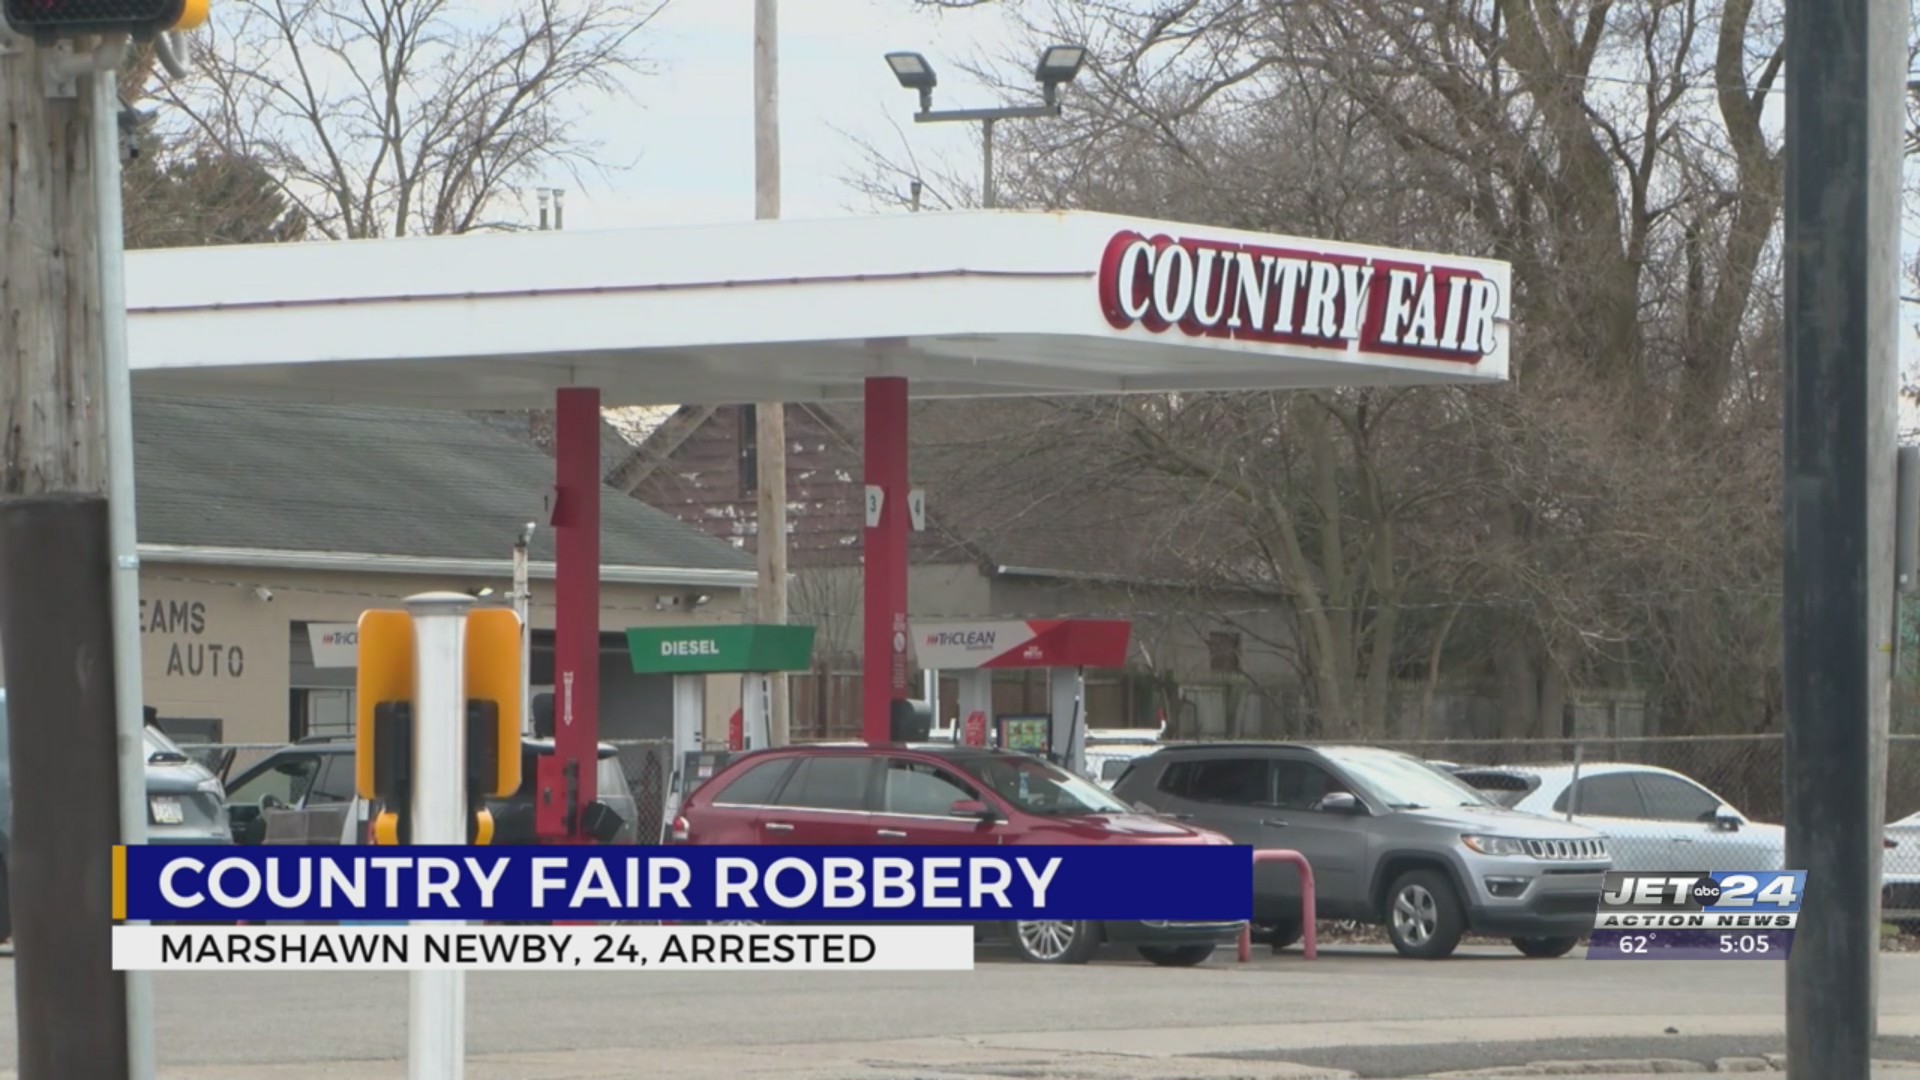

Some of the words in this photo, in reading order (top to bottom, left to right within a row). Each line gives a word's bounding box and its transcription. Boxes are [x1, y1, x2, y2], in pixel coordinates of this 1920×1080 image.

[1118, 240, 1374, 340] COUNTRY
[1380, 268, 1500, 355] FAIR
[869, 494, 877, 513] 3
[166, 643, 244, 677] AUTO
[661, 640, 719, 656] DIESEL
